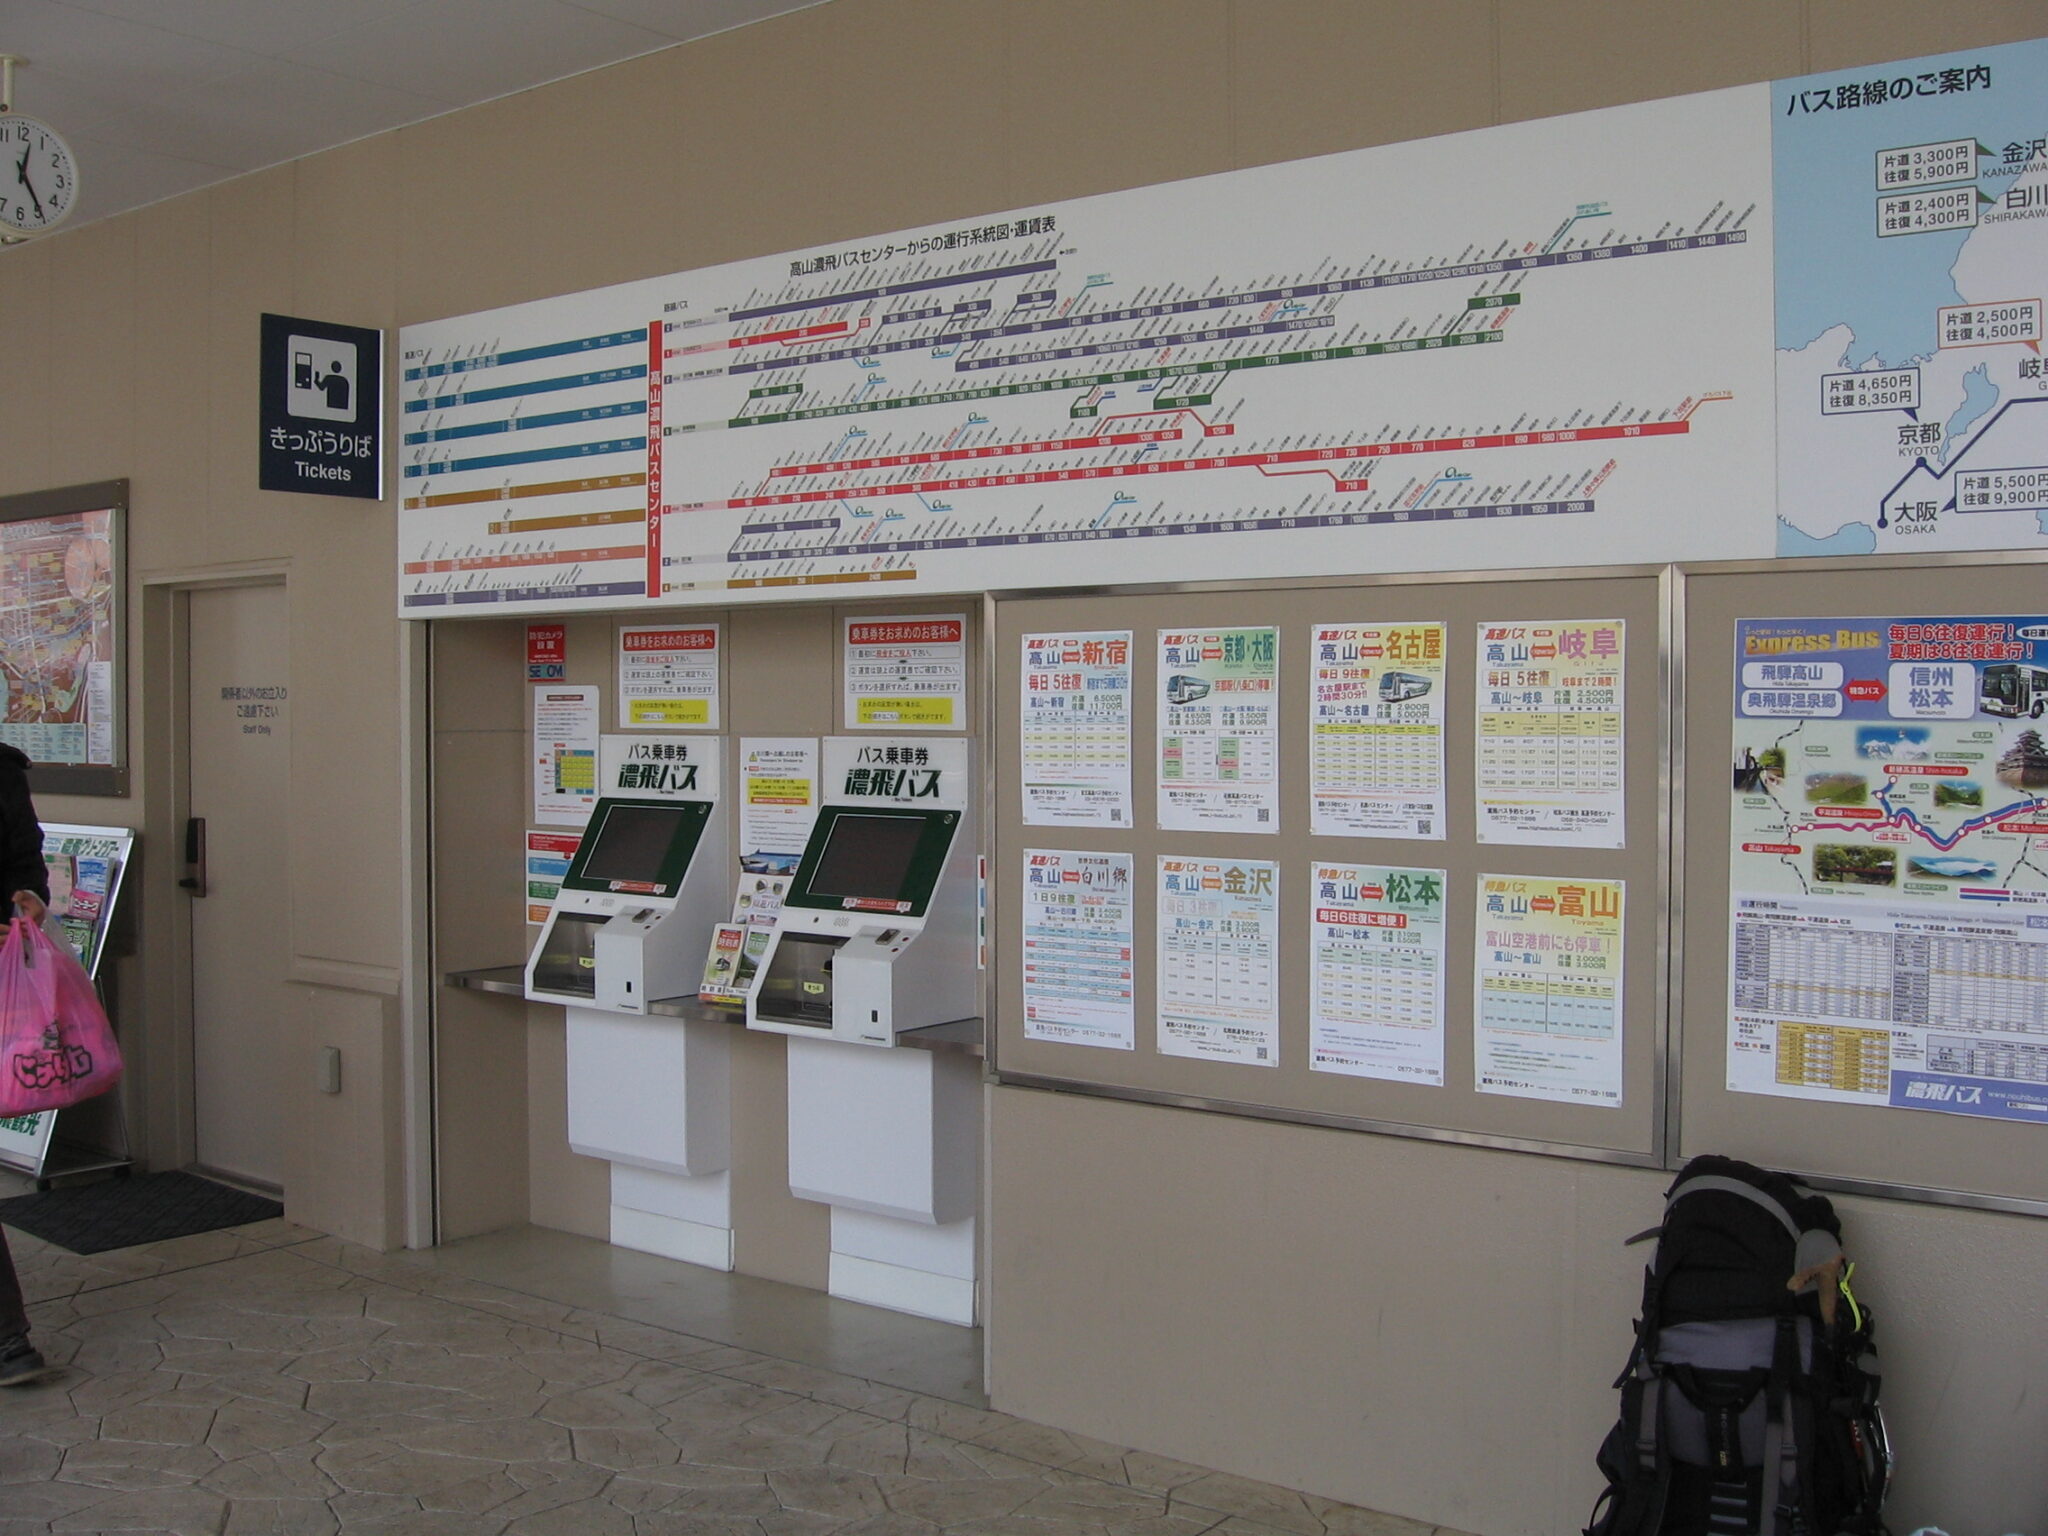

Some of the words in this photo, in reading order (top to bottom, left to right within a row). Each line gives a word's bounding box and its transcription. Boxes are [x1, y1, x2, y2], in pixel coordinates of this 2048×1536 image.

[1786, 64, 1992, 116] バス路線のご案内
[17, 126, 30, 141] 12
[51, 153, 60, 168] 2
[1884, 153, 1910, 168] 片道
[1913, 145, 1969, 166] 3,300円
[2002, 138, 2048, 164] 金沢
[1884, 169, 1910, 184] 往復
[1913, 161, 1969, 182] 5,900円
[1982, 162, 2048, 178] KANAZAWA
[55, 174, 65, 189] 3
[49, 194, 59, 208] 4
[1885, 200, 1911, 215] 片道
[1914, 193, 1970, 213] 2,400円
[16, 207, 25, 221] 6
[1885, 215, 1911, 230] 往復
[1914, 209, 1970, 228] 4,300円
[1984, 208, 2048, 224] SHIRAKAW
[1946, 311, 1972, 326] 片道
[1976, 306, 2034, 325] 2,500円
[1946, 327, 1973, 341] 往復
[1976, 322, 2034, 339] 4,500円
[1829, 379, 1855, 392] 片道
[1858, 374, 1912, 391] 4,650円
[1829, 394, 1855, 408] 往復
[1858, 390, 1912, 406] 8,350円
[269, 426, 373, 459] きっぷうりば
[1897, 422, 1942, 446] 京都
[1898, 445, 1940, 457] KYOTO
[294, 460, 353, 482] Tickets
[1963, 476, 1990, 490] 片道
[1963, 491, 1990, 506] 往復
[1894, 500, 1939, 523] 大阪
[1894, 524, 1937, 535] OSAKA
[852, 624, 959, 640] 乗車券をお求めのお客様へ
[1318, 630, 1357, 641] 高速バス
[1484, 628, 1525, 640] 高速バス
[1887, 623, 2015, 642] 毎日6往復運行！
[1320, 643, 1359, 661] 高山
[1386, 628, 1441, 660] 名古屋
[1487, 643, 1529, 662] 高山
[1558, 628, 1619, 660] 岐阜
[1745, 632, 1833, 655] Express
[1836, 629, 1882, 649] Bus
[1887, 641, 2034, 661] 夏期は8往復運行！
[1028, 651, 1061, 666] 高山
[1082, 638, 1129, 666] 新宿
[1165, 647, 1200, 664] 高山
[529, 665, 563, 678] SEOM
[1319, 669, 1338, 680] 毎日
[1488, 671, 1510, 687] 毎日
[1516, 670, 1551, 687] 5往復
[1909, 666, 1954, 687] 信州
[1028, 674, 1049, 691] 毎日
[1053, 673, 1083, 691] 5往復
[1317, 682, 1367, 694] 名古屋駅まで
[1849, 686, 1880, 695] 特急バス
[1908, 688, 1954, 708] 松本
[628, 743, 687, 761] バス乗車券
[857, 746, 929, 765] バス乗車券
[617, 763, 699, 790] 濃飛バス
[844, 768, 942, 798] 濃飛バス
[1030, 868, 1061, 884] 高山
[1081, 866, 1128, 891] 白川郷
[1165, 874, 1200, 892] 高山
[1223, 866, 1273, 896] 金沢
[1317, 868, 1357, 880] 特急バス
[1320, 882, 1359, 901] 高山
[1386, 873, 1441, 906] 松本
[1486, 894, 1528, 914] 高山
[1557, 885, 1619, 920] 富山
[1486, 930, 1611, 954] 富山空港前にも停車！
